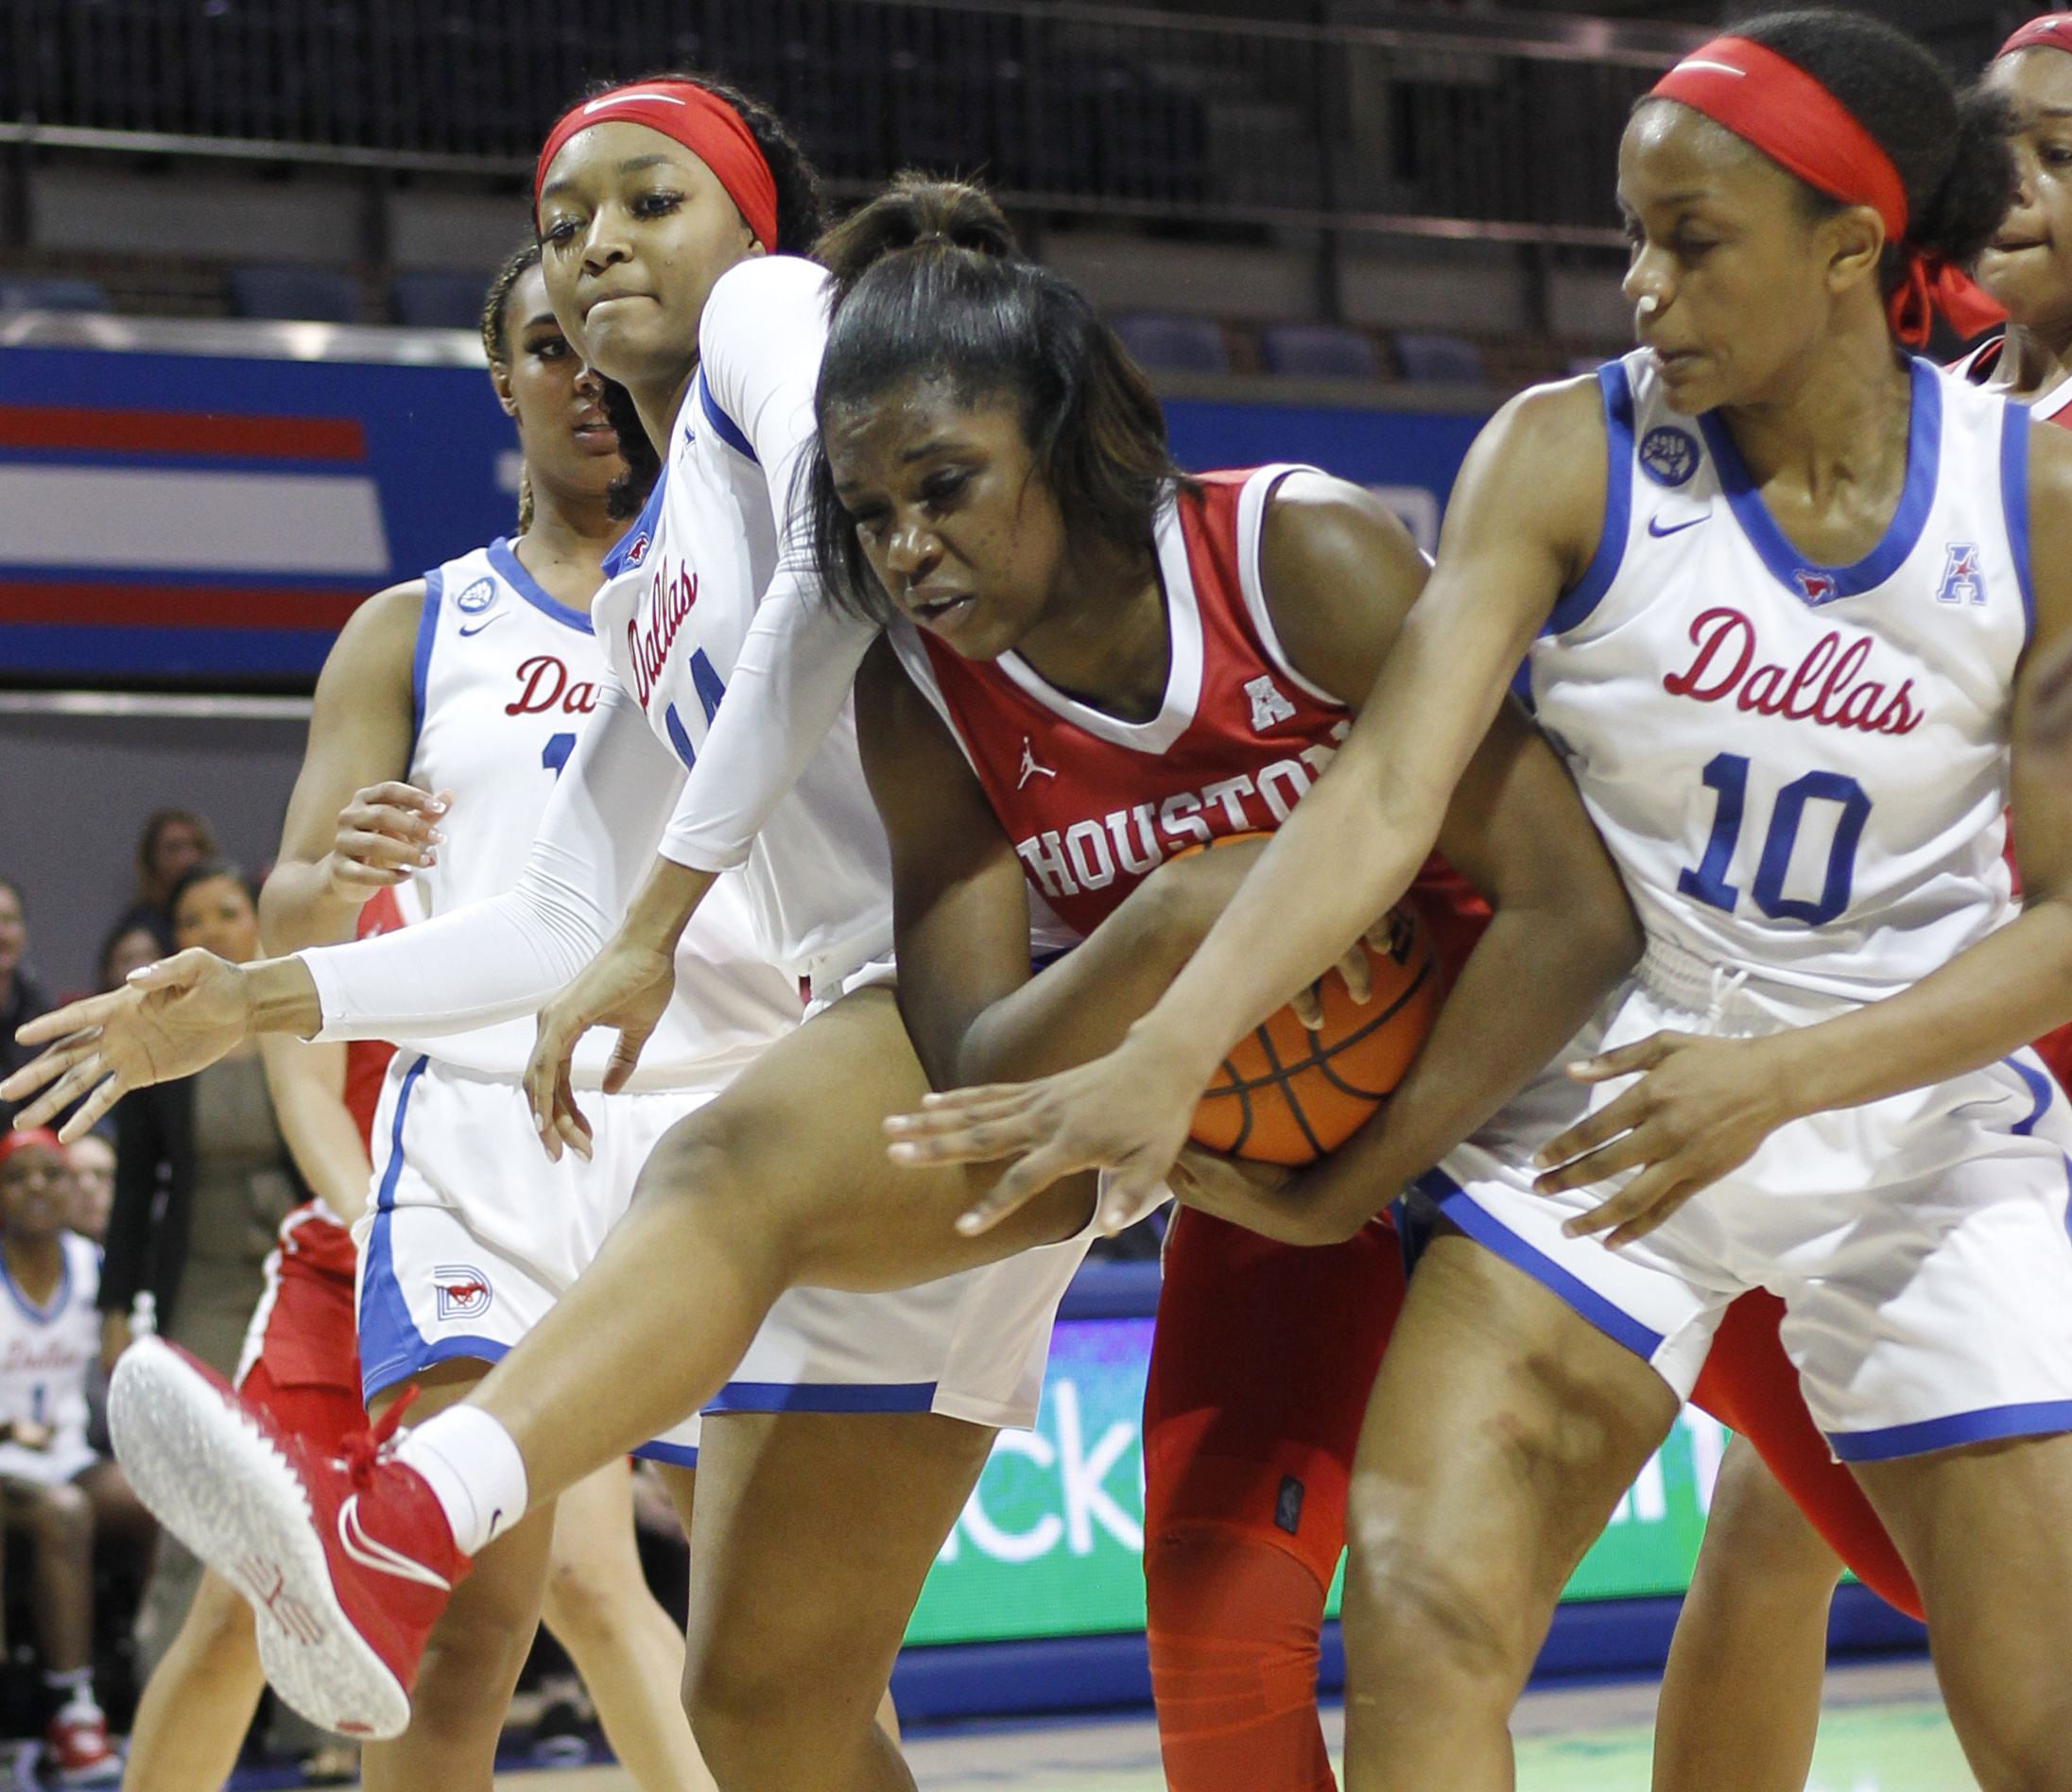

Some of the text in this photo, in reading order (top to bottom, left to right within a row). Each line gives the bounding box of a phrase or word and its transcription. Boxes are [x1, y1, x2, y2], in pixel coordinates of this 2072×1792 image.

[505, 655, 602, 716] Da
[629, 555, 698, 716] Dallas
[1664, 607, 1925, 734] Dallas
[1677, 752, 1873, 926] 10
[936, 1378, 1147, 1562] ck
